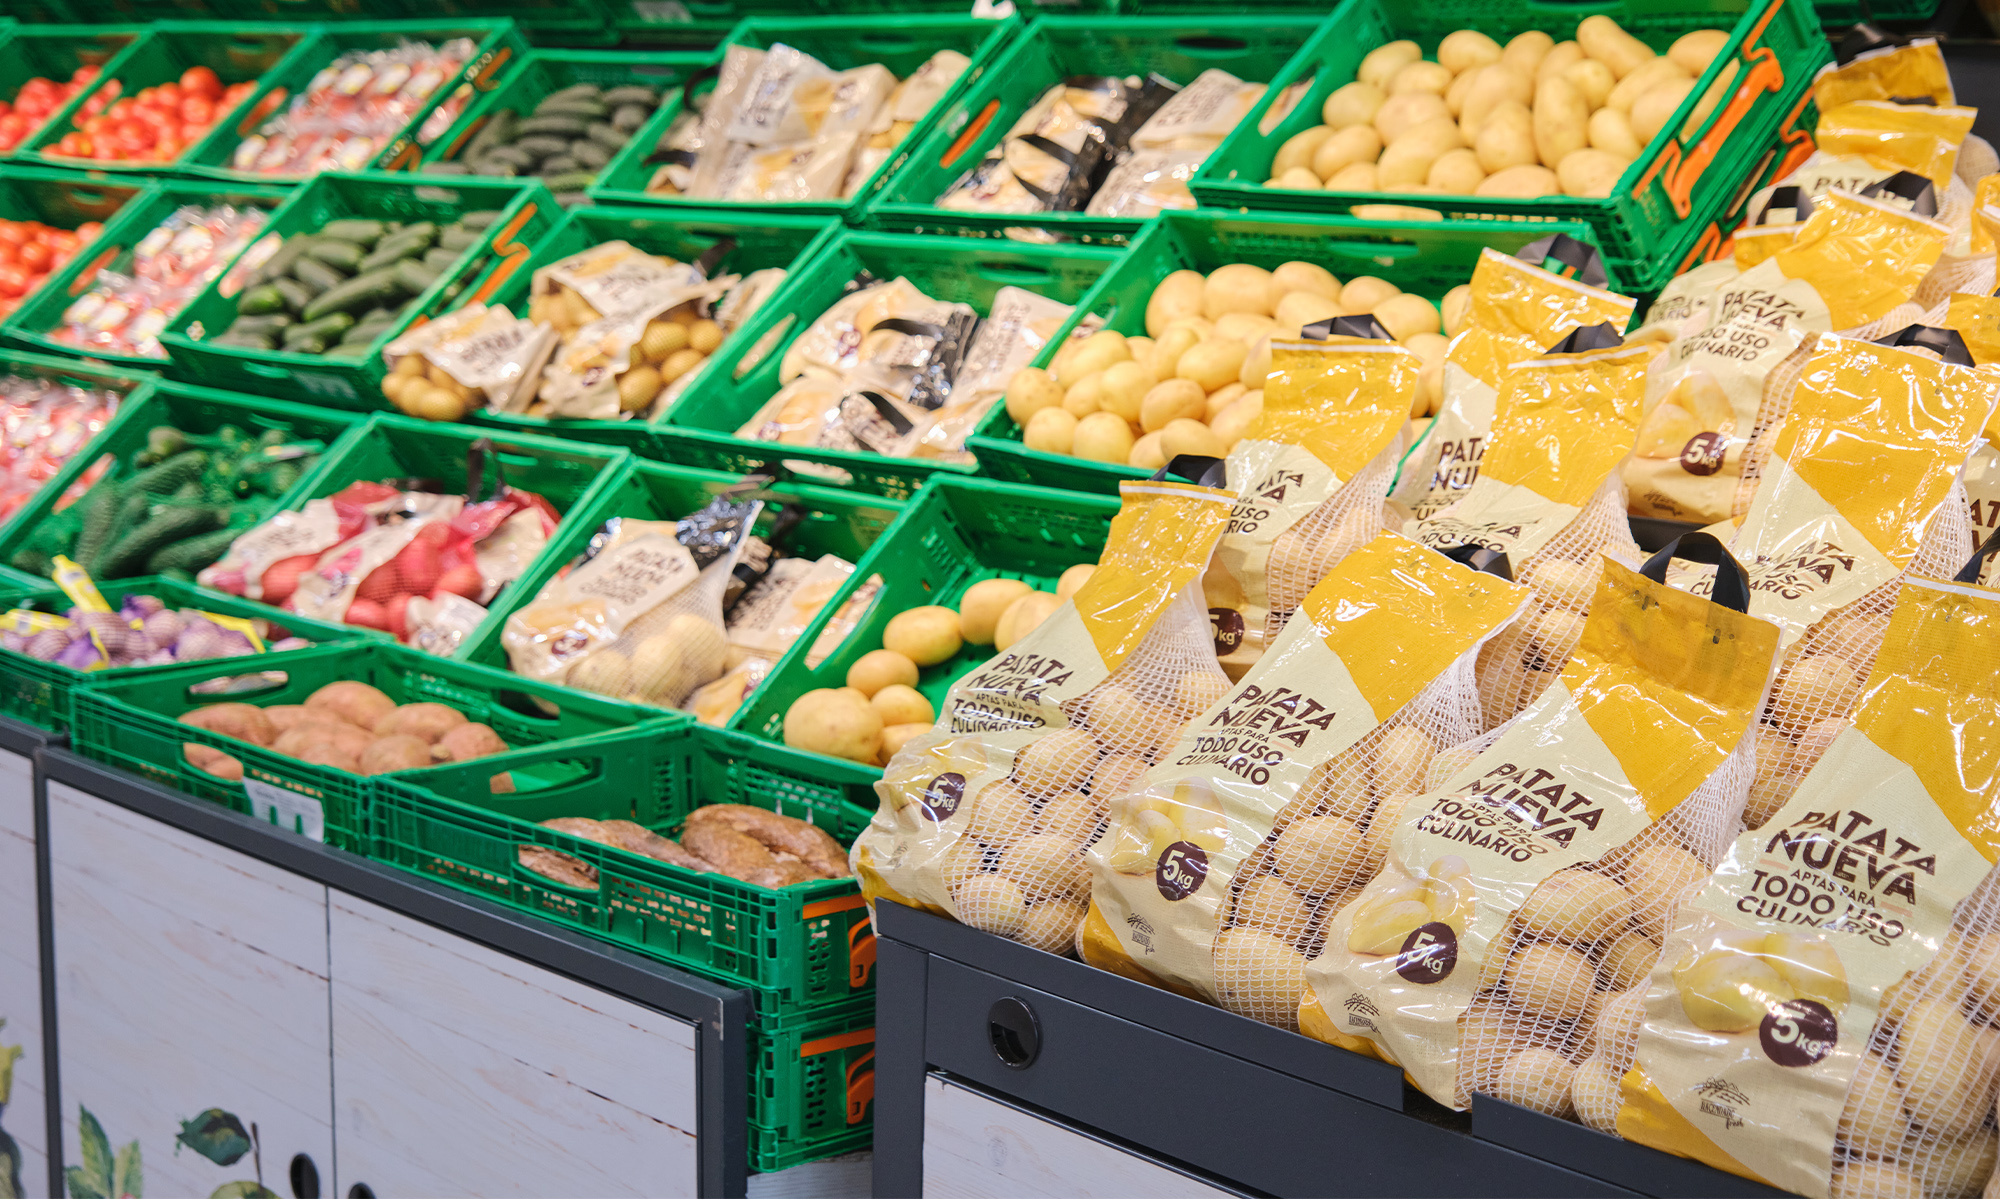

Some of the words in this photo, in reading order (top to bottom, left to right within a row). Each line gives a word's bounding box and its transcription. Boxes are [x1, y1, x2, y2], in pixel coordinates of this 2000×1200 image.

[1730, 330, 1770, 350] USO
[1685, 438, 1718, 468] 5kg
[1223, 519, 1258, 535] RIO
[1230, 505, 1270, 520] USO
[967, 673, 1049, 706] NUEVA
[992, 653, 1075, 687] PATATA
[952, 698, 1004, 720] TODO
[1009, 710, 1047, 729] USO
[1208, 707, 1311, 748] NUEVA
[1231, 684, 1337, 731] PATATA
[1192, 736, 1239, 753] TODO
[1238, 739, 1284, 766] USO
[1221, 727, 1243, 736] APTAS
[1243, 729, 1270, 743] PARA
[1176, 754, 1270, 786] CULINARIO
[928, 779, 956, 812] 5kg
[1455, 779, 1577, 849] NUEVA
[1484, 763, 1605, 831] PATATA
[1417, 814, 1533, 862] CULINARIO
[1430, 798, 1497, 827] TODO
[1497, 828, 1549, 855] USO
[1470, 802, 1504, 822] APTAS
[1503, 821, 1533, 838] PARA
[1789, 810, 1936, 876] PATATA
[1162, 849, 1195, 890] 5kg
[1764, 829, 1917, 906] NUEVA
[1751, 869, 1836, 915] TODO
[1846, 903, 1905, 939] USO
[1790, 868, 1837, 892] APTAS
[1839, 885, 1876, 908] PARA
[1736, 895, 1892, 947] CULINARIO
[1406, 931, 1444, 975] 5kg
[1770, 1007, 1823, 1059] 5kg
